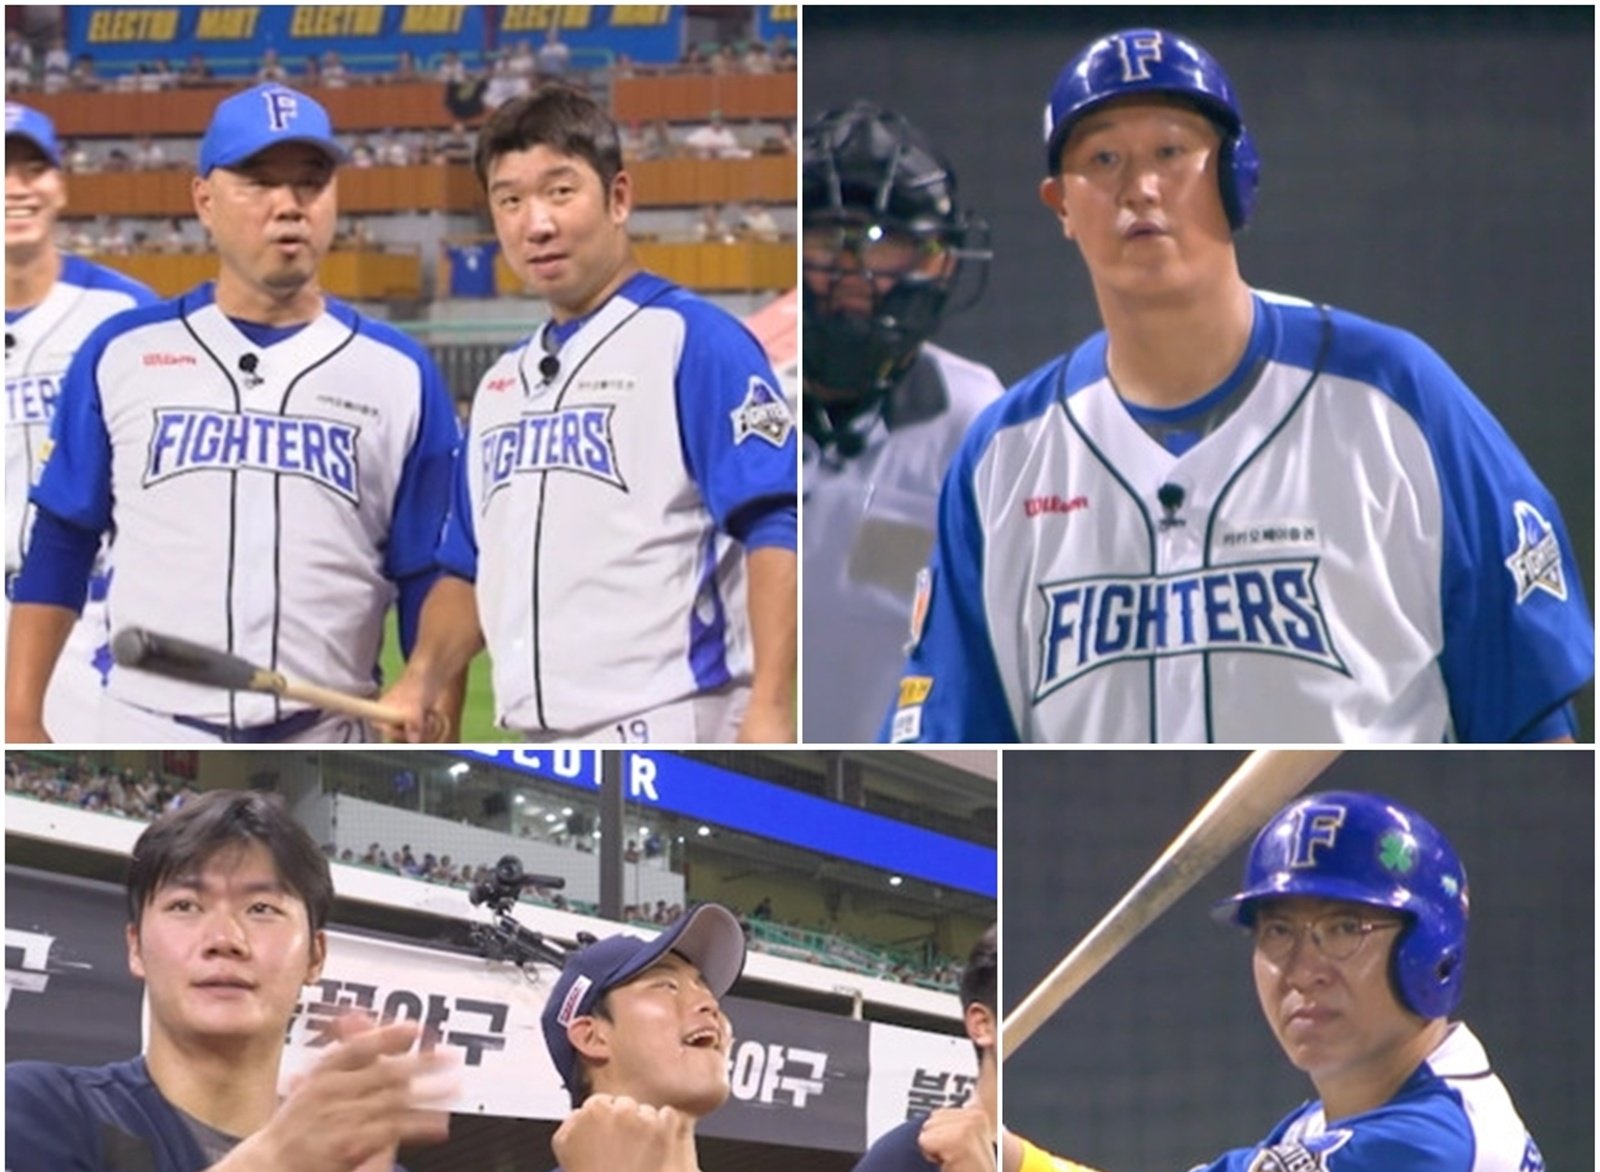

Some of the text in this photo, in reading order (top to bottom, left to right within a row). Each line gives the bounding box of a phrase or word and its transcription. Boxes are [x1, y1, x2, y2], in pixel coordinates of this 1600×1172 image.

[1112, 29, 1163, 83] F
[261, 90, 298, 131] F
[151, 411, 355, 493] FIGHTERS
[1045, 571, 1327, 682] FIGHTERS
[616, 720, 648, 743] 19
[1290, 804, 1345, 867] F
